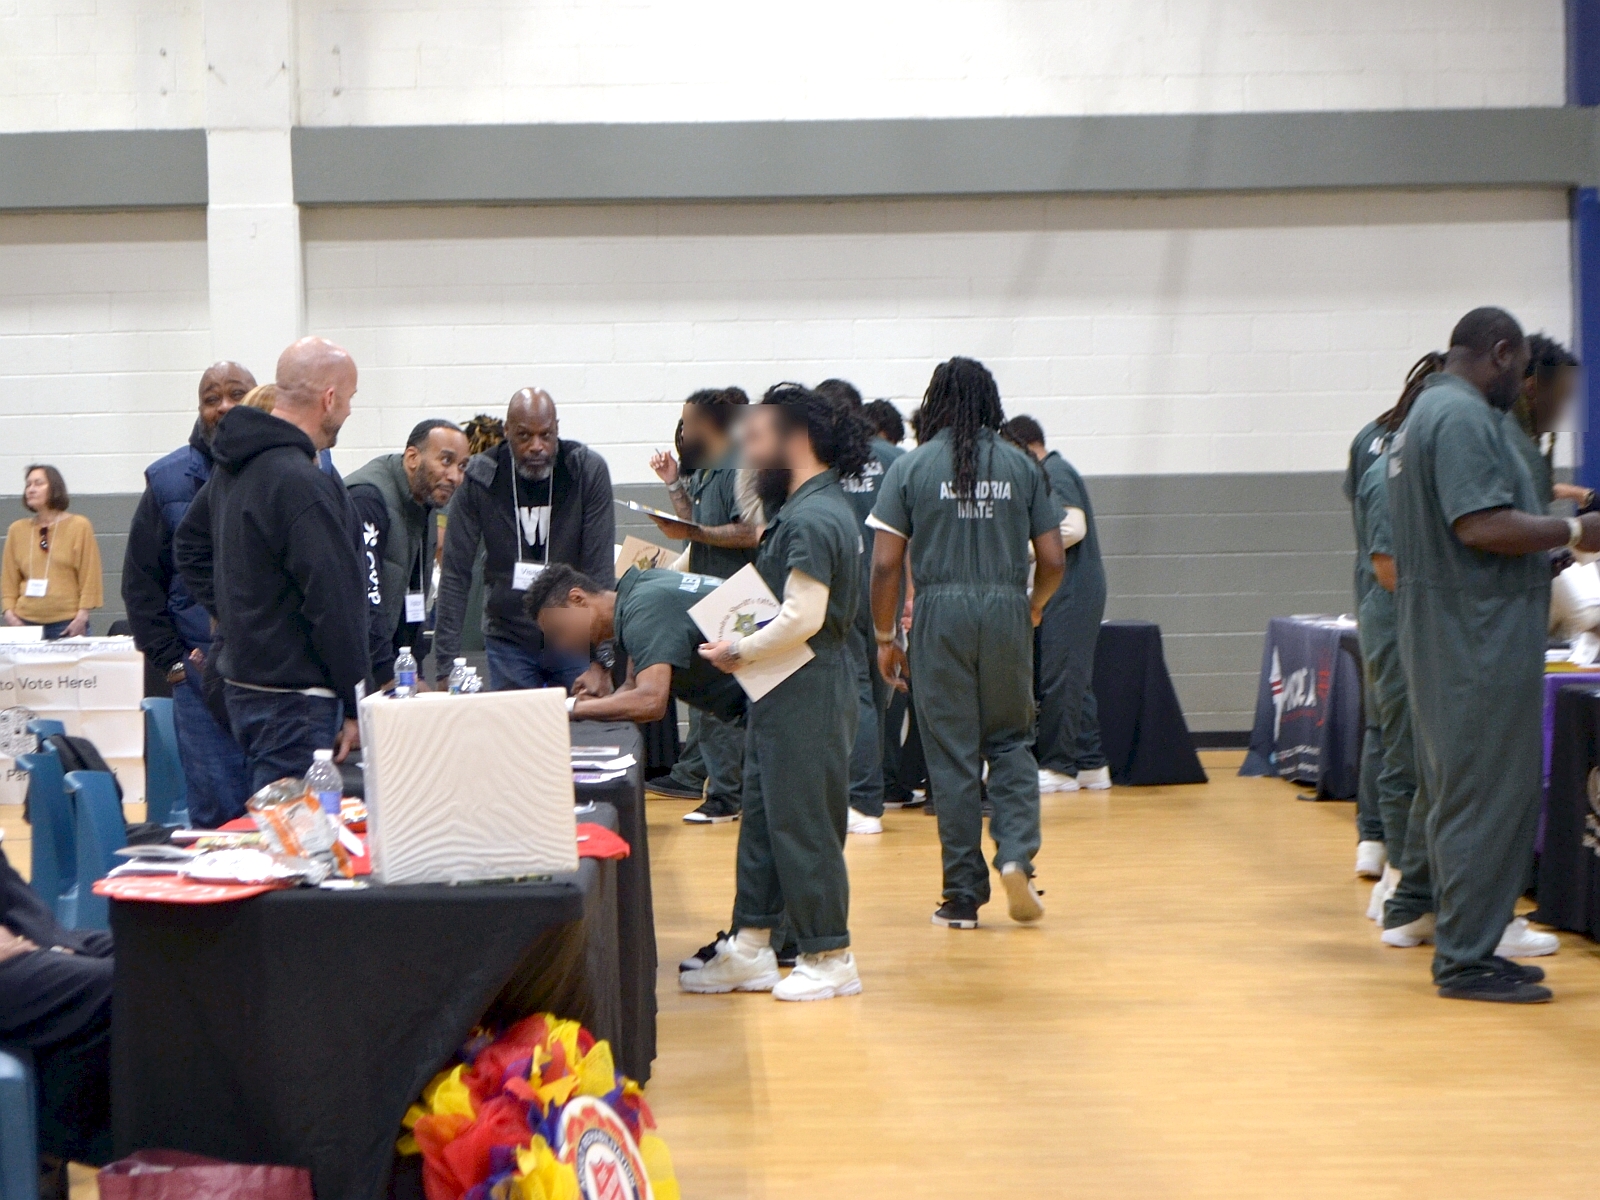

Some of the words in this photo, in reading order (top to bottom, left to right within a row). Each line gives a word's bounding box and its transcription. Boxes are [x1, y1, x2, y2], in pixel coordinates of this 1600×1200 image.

[0, 681, 15, 691] to
[17, 677, 53, 690] Vote
[57, 675, 98, 689] Here!
